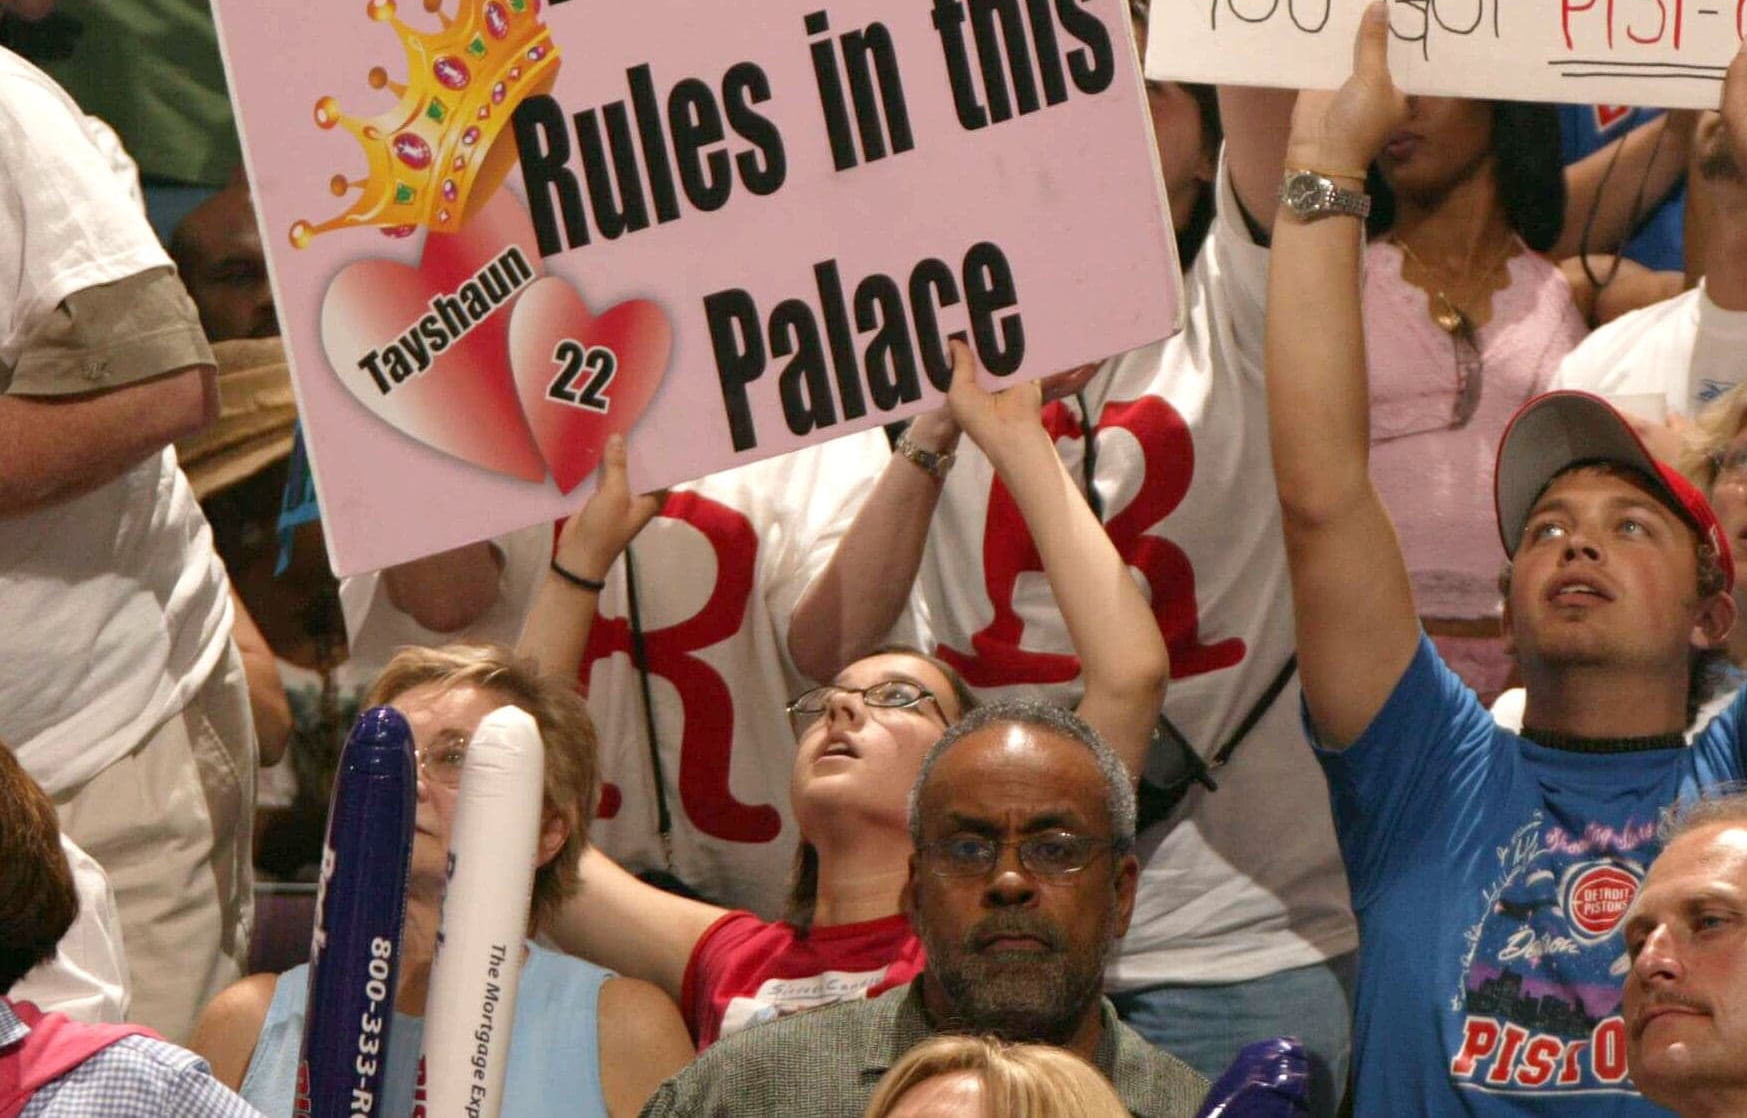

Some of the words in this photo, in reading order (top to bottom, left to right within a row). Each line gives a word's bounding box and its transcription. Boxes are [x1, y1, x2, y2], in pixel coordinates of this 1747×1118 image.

[512, 63, 787, 258] Rules
[804, 9, 915, 174] in
[357, 244, 537, 398] Tayshaun
[703, 240, 1025, 454] Palace
[547, 342, 616, 410] 22
[1583, 887, 1630, 902] DETROIT
[487, 943, 507, 980] The
[470, 982, 502, 1081] Mortgage
[1451, 1016, 1628, 1087] PISTO
[463, 1084, 487, 1118] Exp
